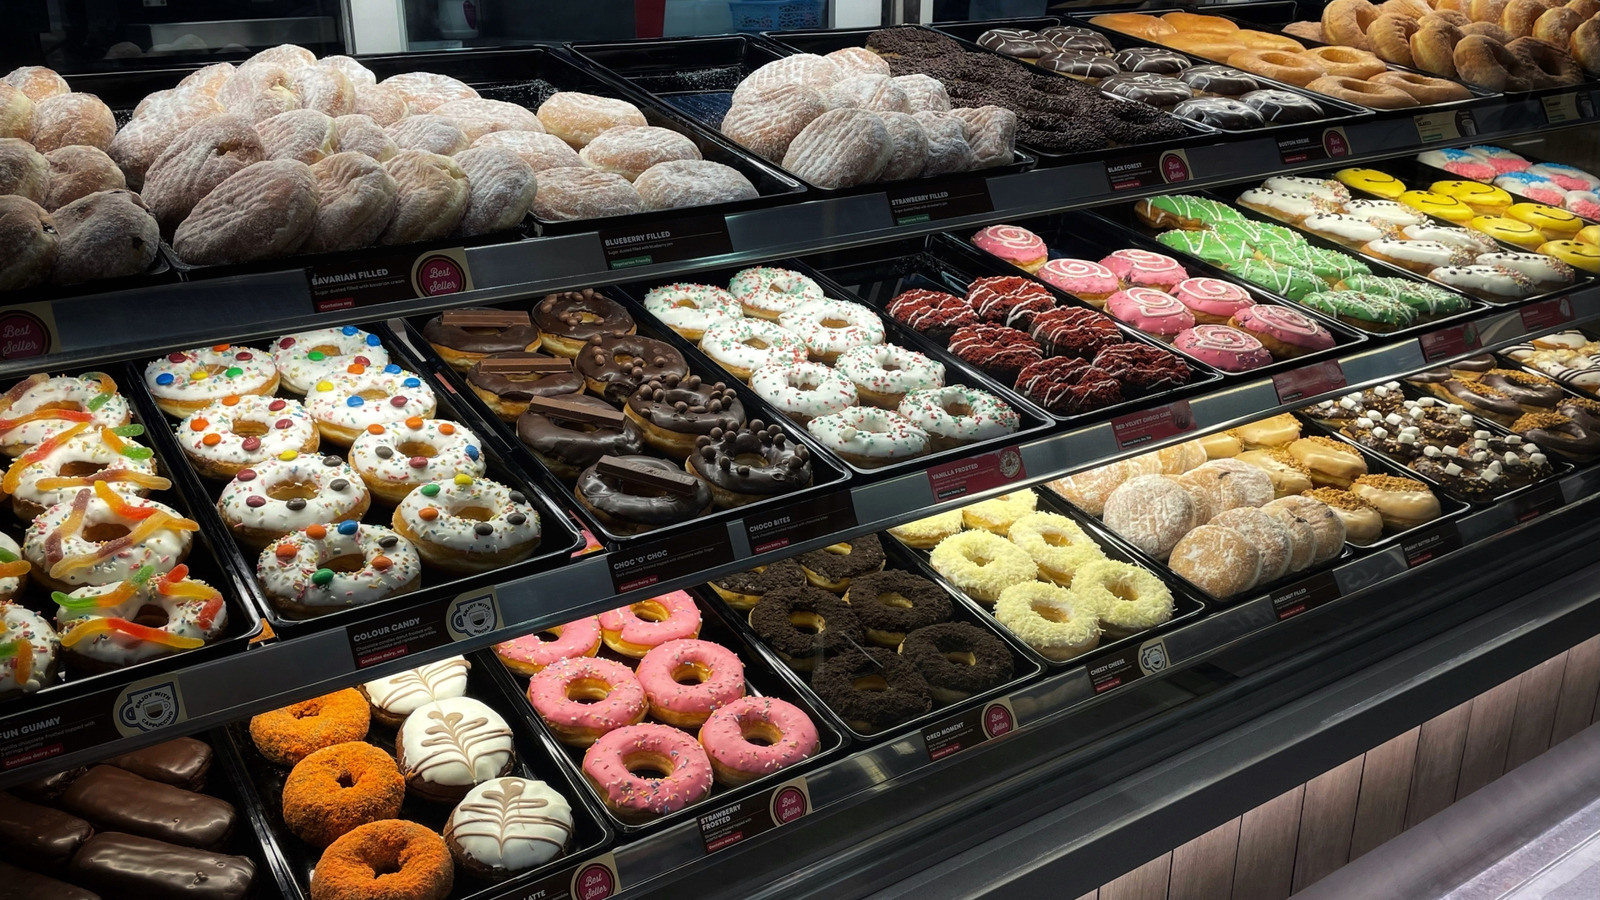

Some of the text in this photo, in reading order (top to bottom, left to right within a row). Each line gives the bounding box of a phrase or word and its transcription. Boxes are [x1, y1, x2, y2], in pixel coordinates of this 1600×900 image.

[1107, 162, 1142, 173] BLACK FOREST
[891, 191, 949, 206] STRAWBERRY FILLED
[604, 231, 671, 247] BLUEBERRY FILLED
[311, 268, 389, 286] BAVARIAN FILLED
[429, 267, 451, 279] Best
[314, 288, 327, 297] Sugar
[329, 285, 346, 294] dusted
[429, 281, 457, 294] Seller
[320, 302, 343, 310] Contains
[2, 324, 31, 338] Best
[2, 340, 39, 357] Seller
[1125, 418, 1142, 427] VELVET
[1142, 414, 1159, 423] CHOCO
[931, 470, 954, 480] VANILLA
[954, 463, 979, 474] FROSTED
[749, 516, 791, 533] CHOCO BITES
[613, 549, 668, 570] CHOC 'O' CHOC
[463, 602, 491, 617] ENJOY WITH
[353, 617, 420, 643] COLOUR CANDY
[355, 642, 378, 652] Chocolate
[361, 655, 383, 665] Contains
[1090, 665, 1108, 676] CHEEZY
[1108, 658, 1126, 669] CHEESE
[135, 691, 171, 709] ENJOY WITH
[21, 715, 61, 734] GUMMY
[141, 710, 174, 728] CAPPUCCINO
[991, 712, 1004, 723] Best
[926, 731, 941, 741] OREO
[941, 721, 964, 736] MOMENT
[5, 754, 32, 766] Contains
[781, 794, 797, 808] Best
[700, 804, 741, 825] STRAWBERRY
[782, 806, 801, 820] Seller
[702, 815, 731, 832] FROSTED
[584, 872, 603, 887] Best
[585, 884, 608, 900] Seller
